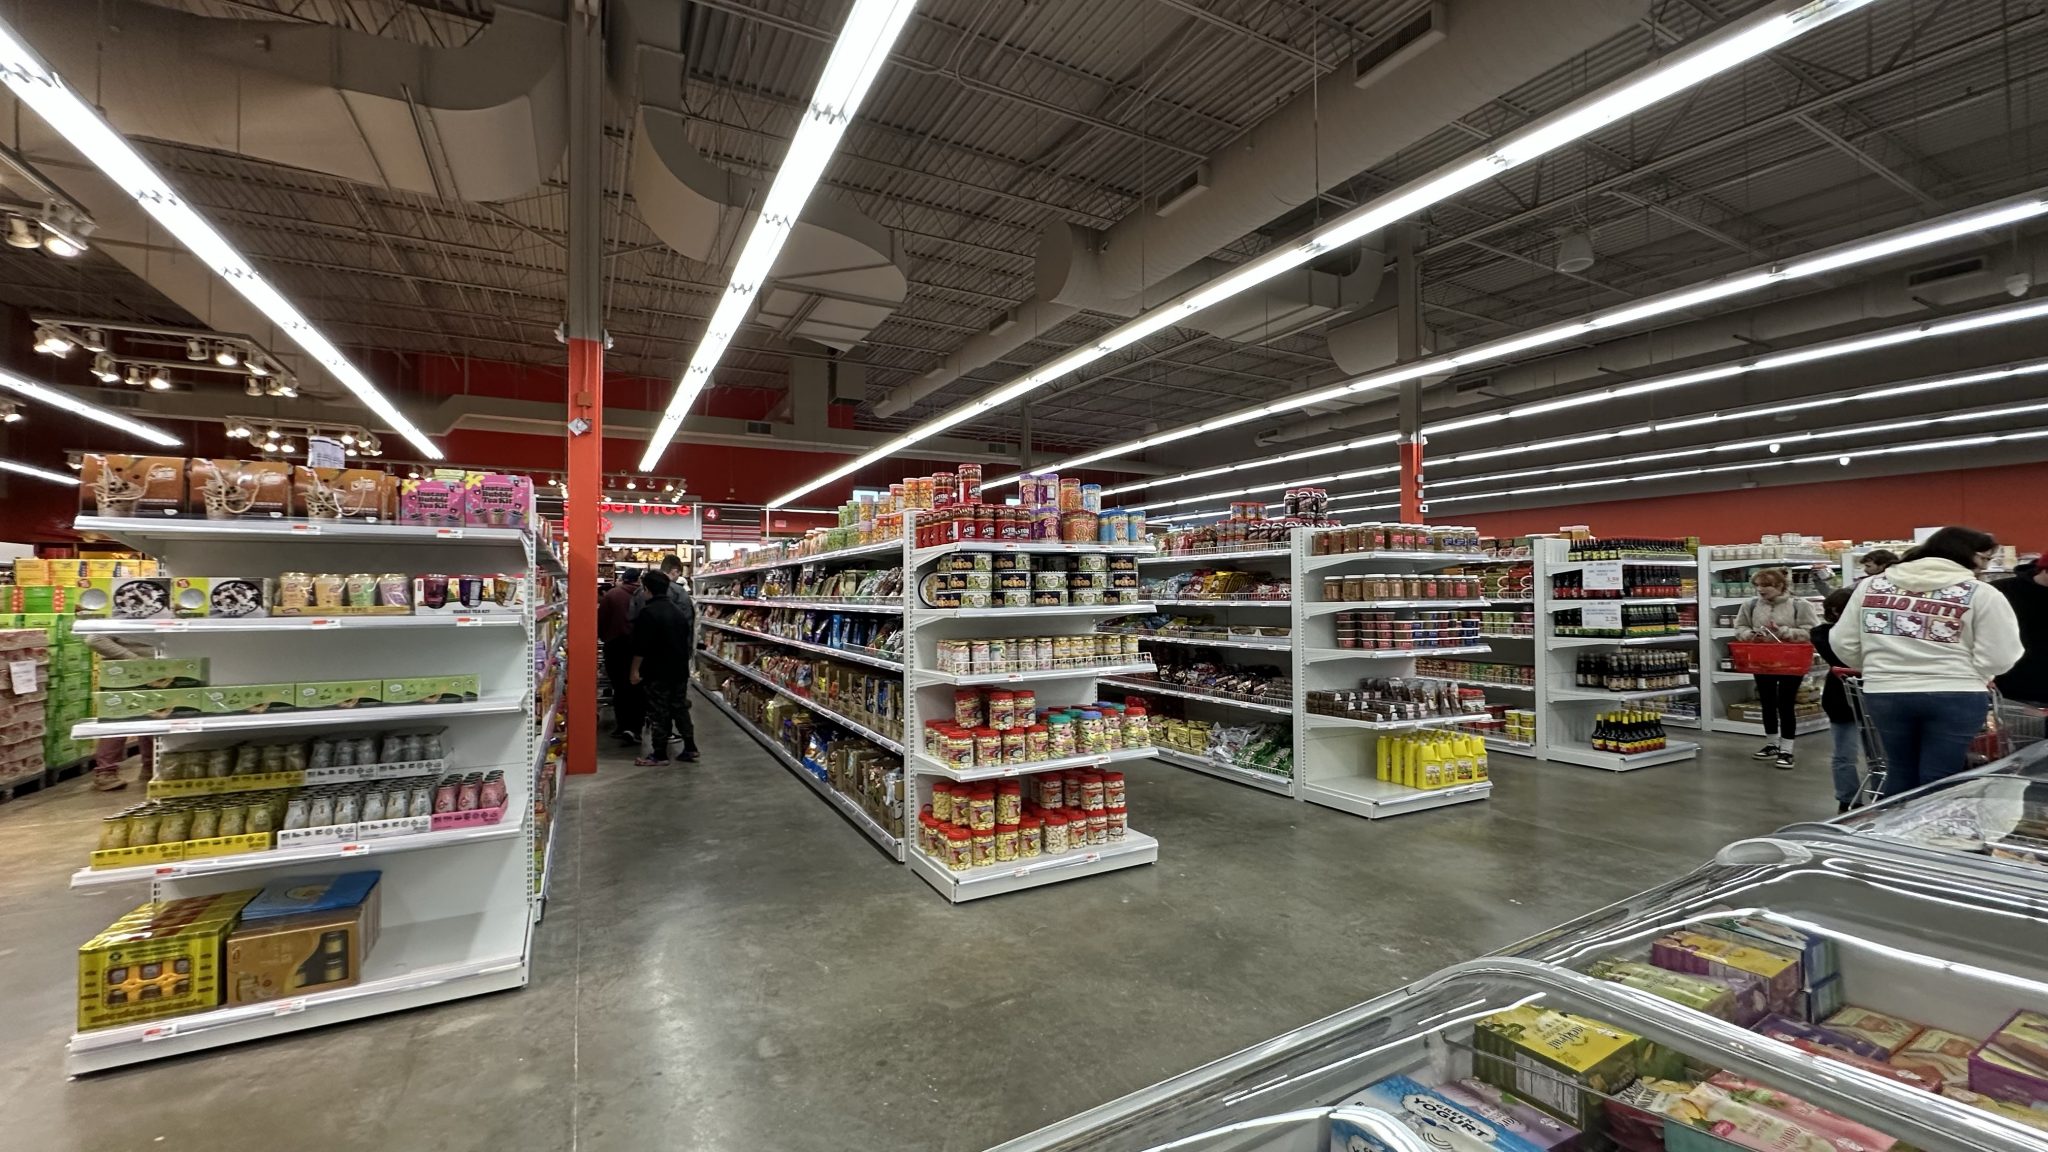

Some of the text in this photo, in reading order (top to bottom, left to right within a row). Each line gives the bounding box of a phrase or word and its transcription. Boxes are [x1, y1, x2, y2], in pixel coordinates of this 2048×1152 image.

[417, 490, 449, 498] Instant
[706, 509, 716, 519] 4
[1861, 594, 1971, 619] HELLO KITTY
[1414, 1097, 1489, 1137] YOGURT
[1436, 1103, 1474, 1124] GREEK
